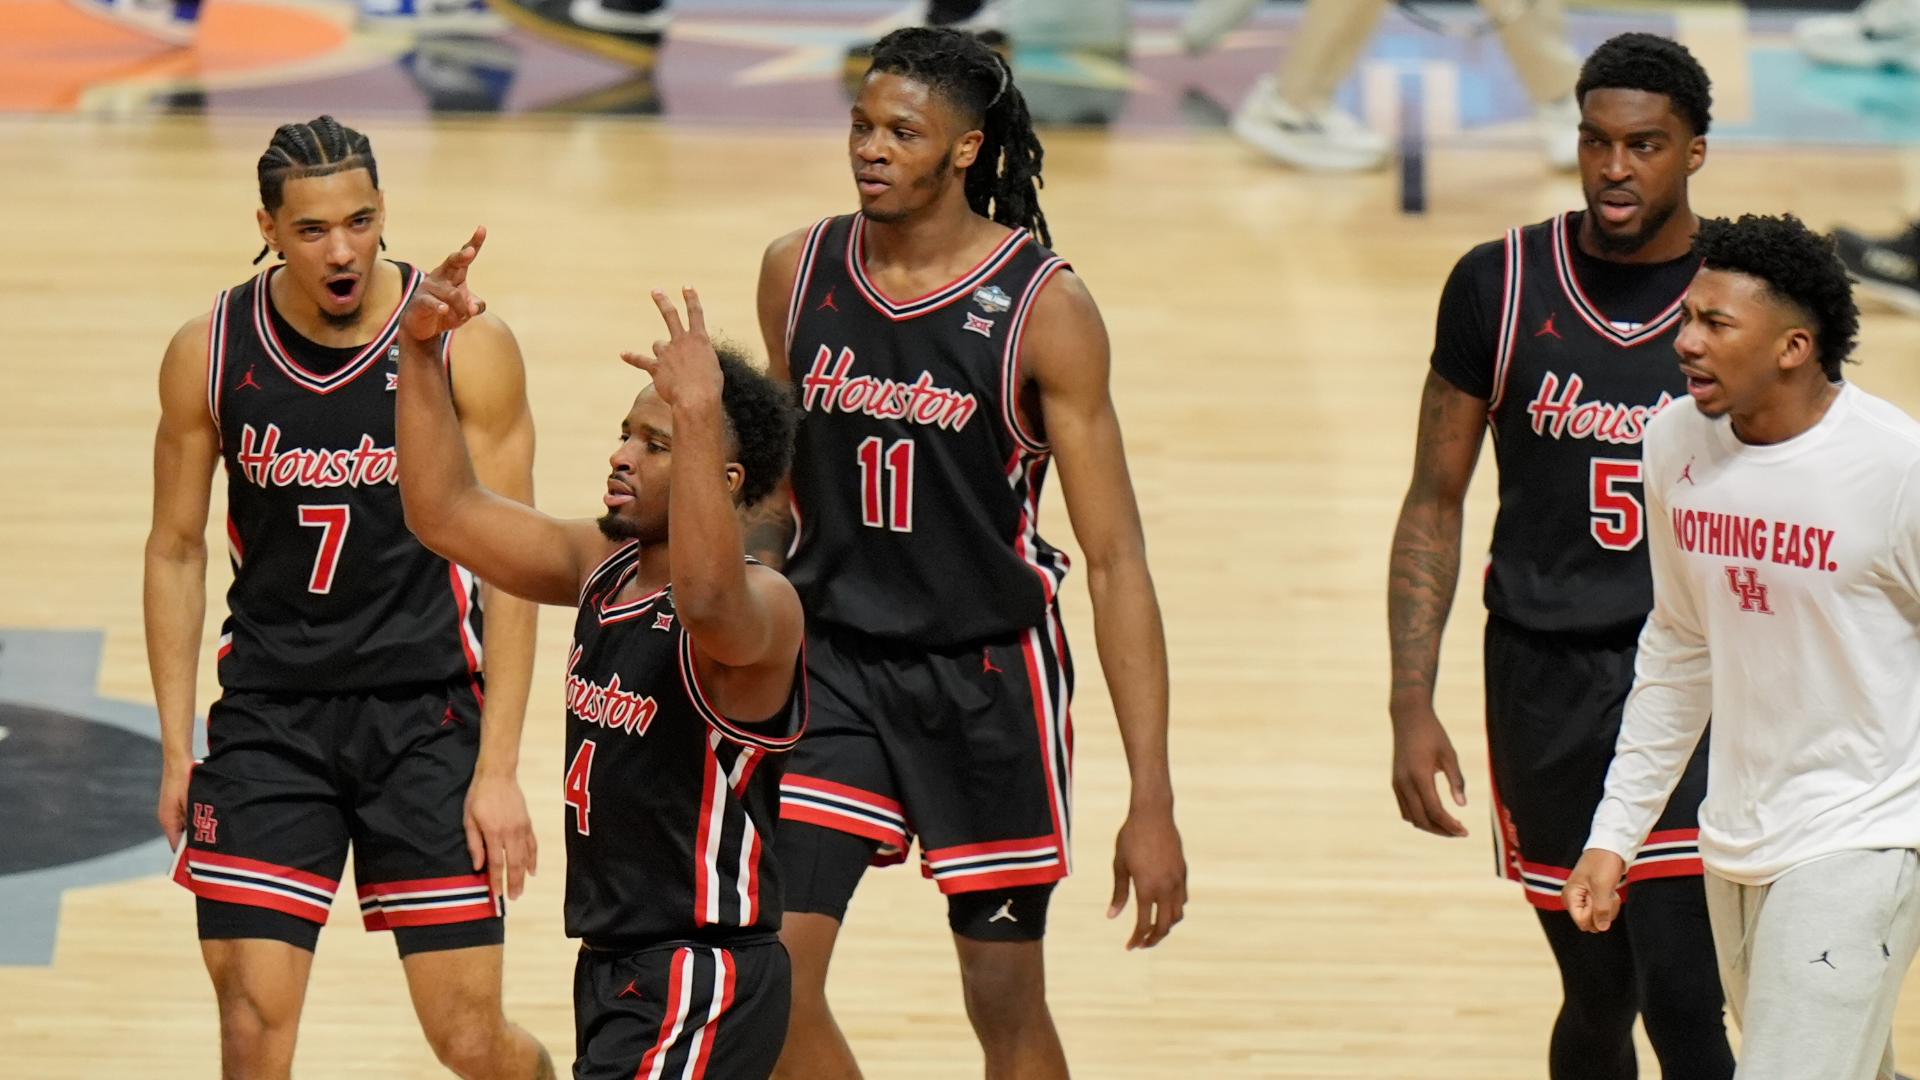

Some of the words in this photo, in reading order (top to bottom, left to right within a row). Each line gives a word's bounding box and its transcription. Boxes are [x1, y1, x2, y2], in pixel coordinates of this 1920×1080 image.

[802, 344, 977, 432] Houston
[857, 436, 914, 533] 11
[1590, 457, 1643, 551] 5
[298, 504, 350, 594] 7
[1673, 507, 1767, 561] NOTHING
[1771, 521, 1838, 572] EASY.
[565, 739, 596, 837] 4
